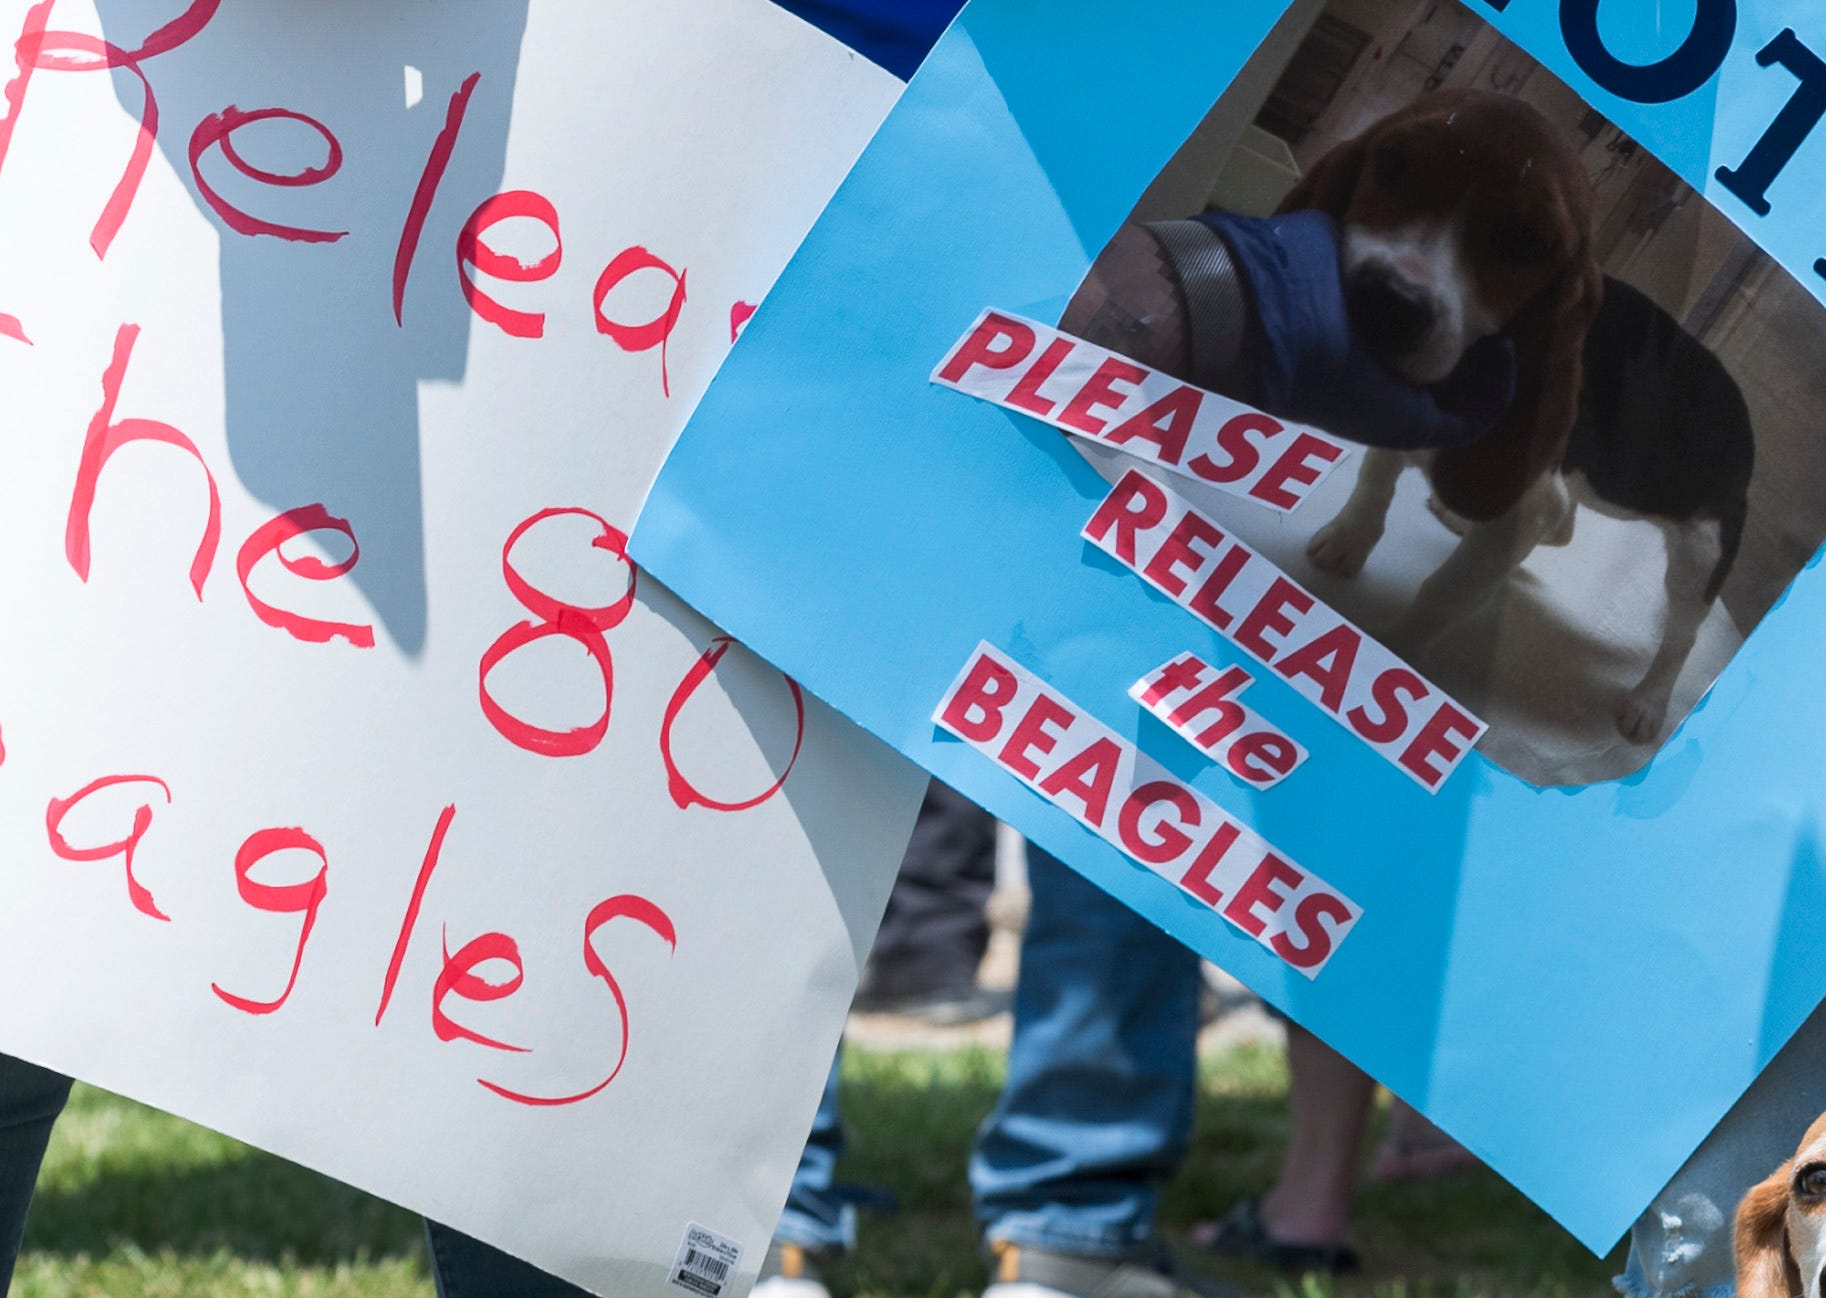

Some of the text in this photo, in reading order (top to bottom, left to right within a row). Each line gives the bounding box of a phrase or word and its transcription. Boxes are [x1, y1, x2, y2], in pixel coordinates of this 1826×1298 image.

[0, 0, 758, 399] Relea
[0, 311, 805, 811] he 80
[938, 311, 1344, 510] PLEASE
[1084, 469, 1480, 786] RELEASE
[1140, 656, 1298, 782] the
[0, 722, 678, 1106] agles
[941, 653, 1354, 968] BEAGLES
